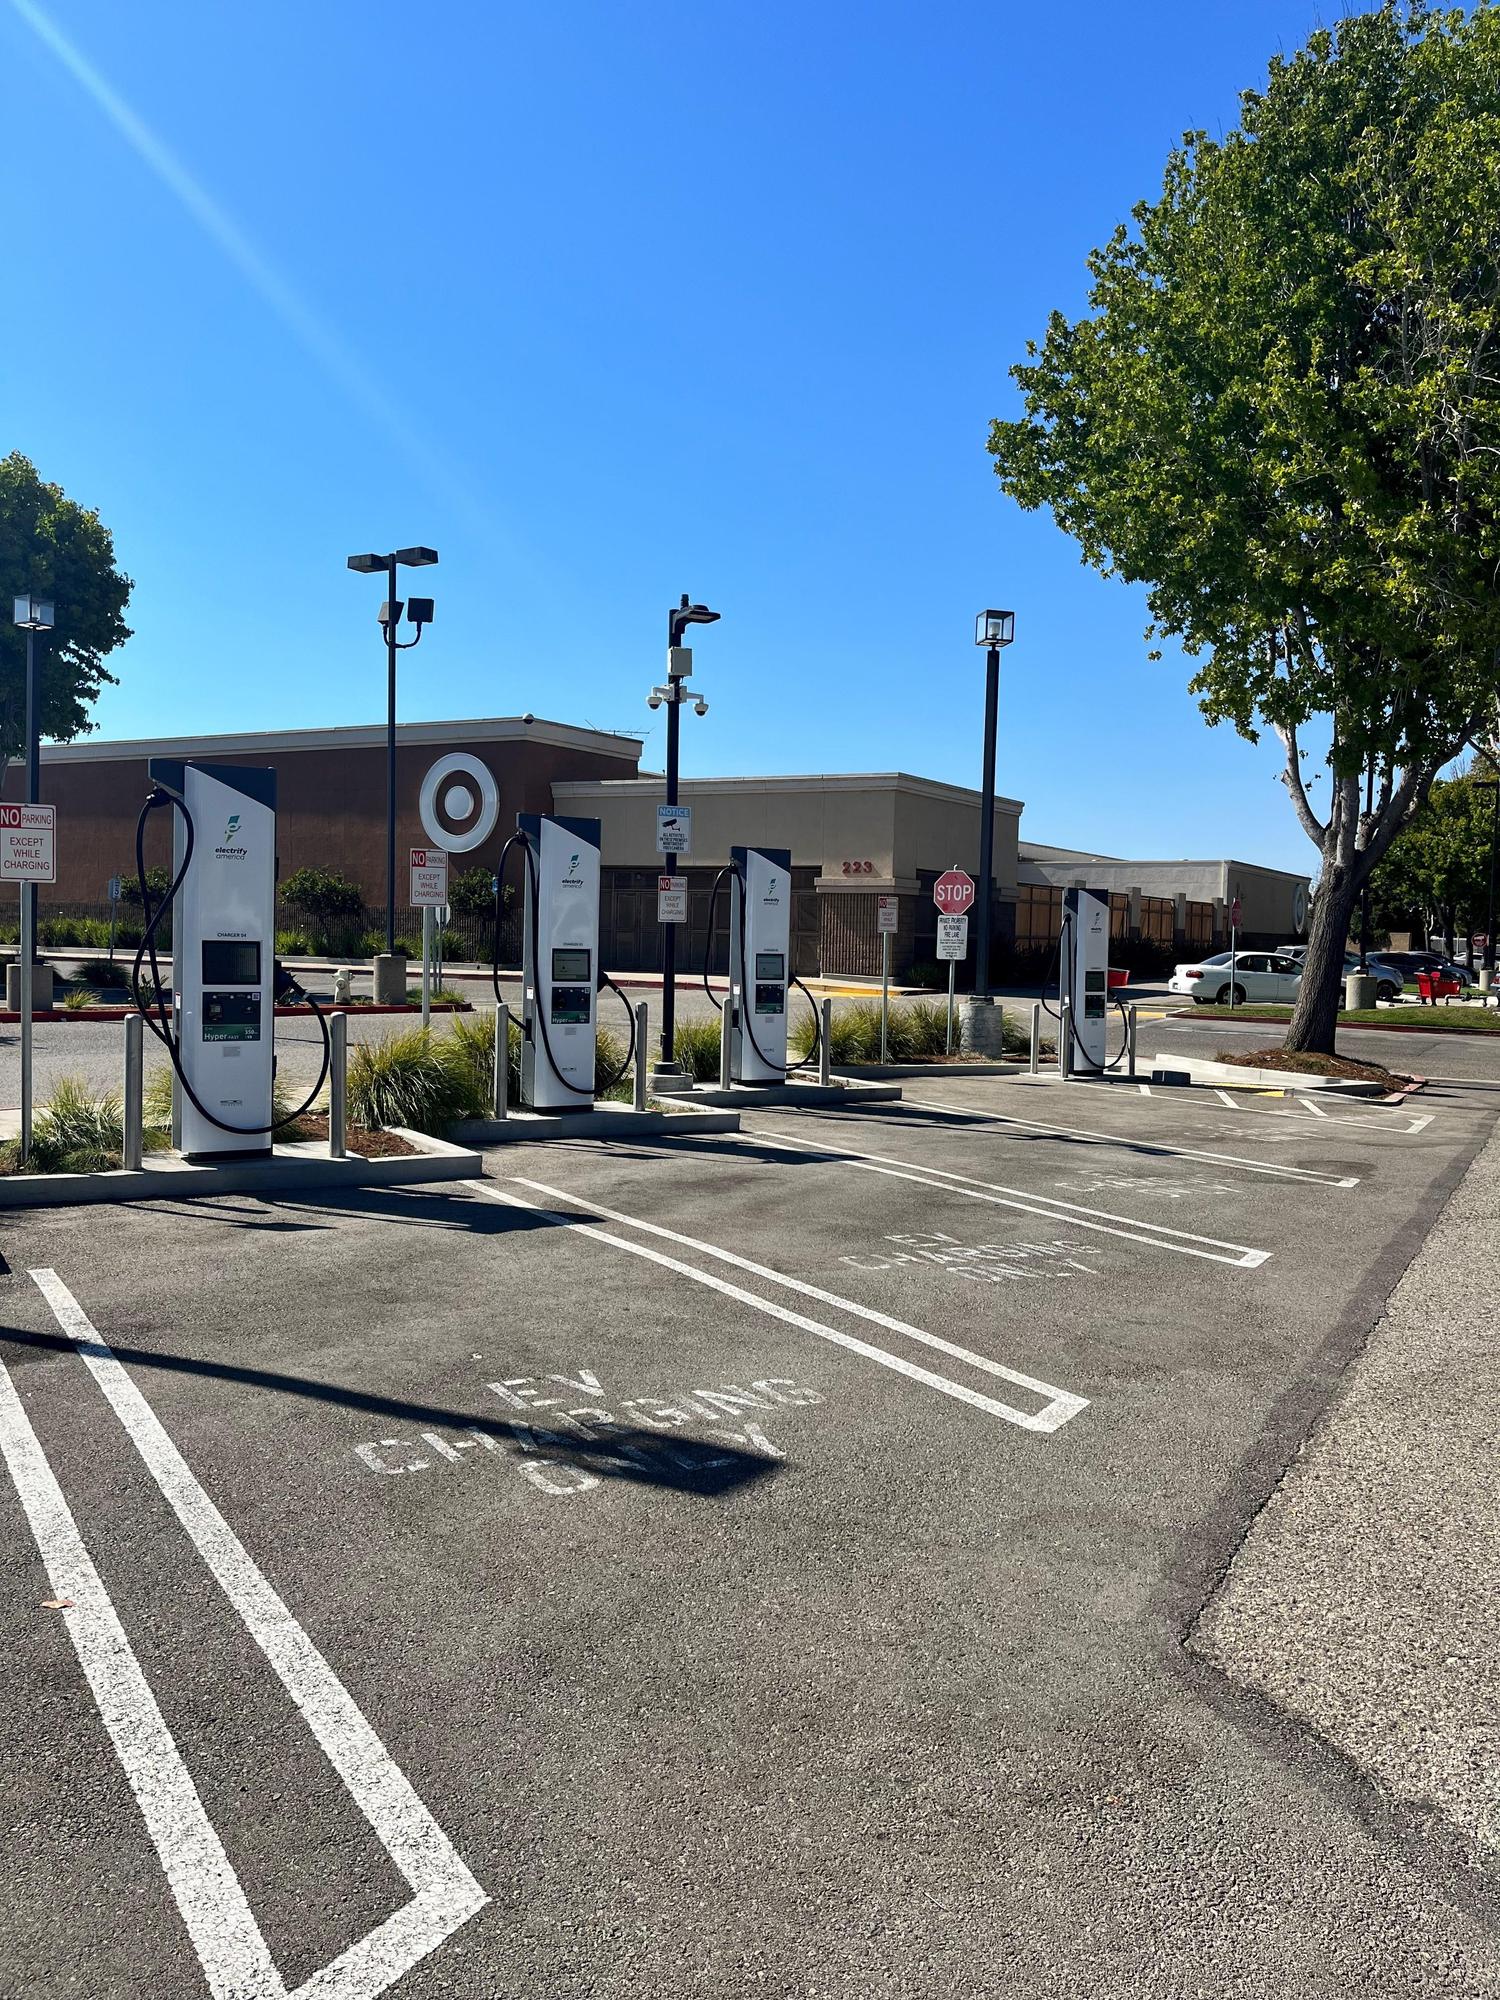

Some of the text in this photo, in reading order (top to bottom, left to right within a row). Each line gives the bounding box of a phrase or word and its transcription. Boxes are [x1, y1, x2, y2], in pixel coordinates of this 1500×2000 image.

[0, 809, 52, 825] NO PARKING
[660, 808, 688, 816] NOTICE
[10, 837, 43, 847] EXCEPT
[14, 849, 40, 858] WHILE
[215, 847, 247, 855] electrify
[412, 852, 425, 865] NO
[4, 860, 50, 870] CHARGING
[842, 861, 873, 873] 223
[661, 880, 670, 889] NO
[937, 885, 971, 900] STOP
[487, 1369, 607, 1410] EV
[354, 1377, 827, 1476] CHARGING
